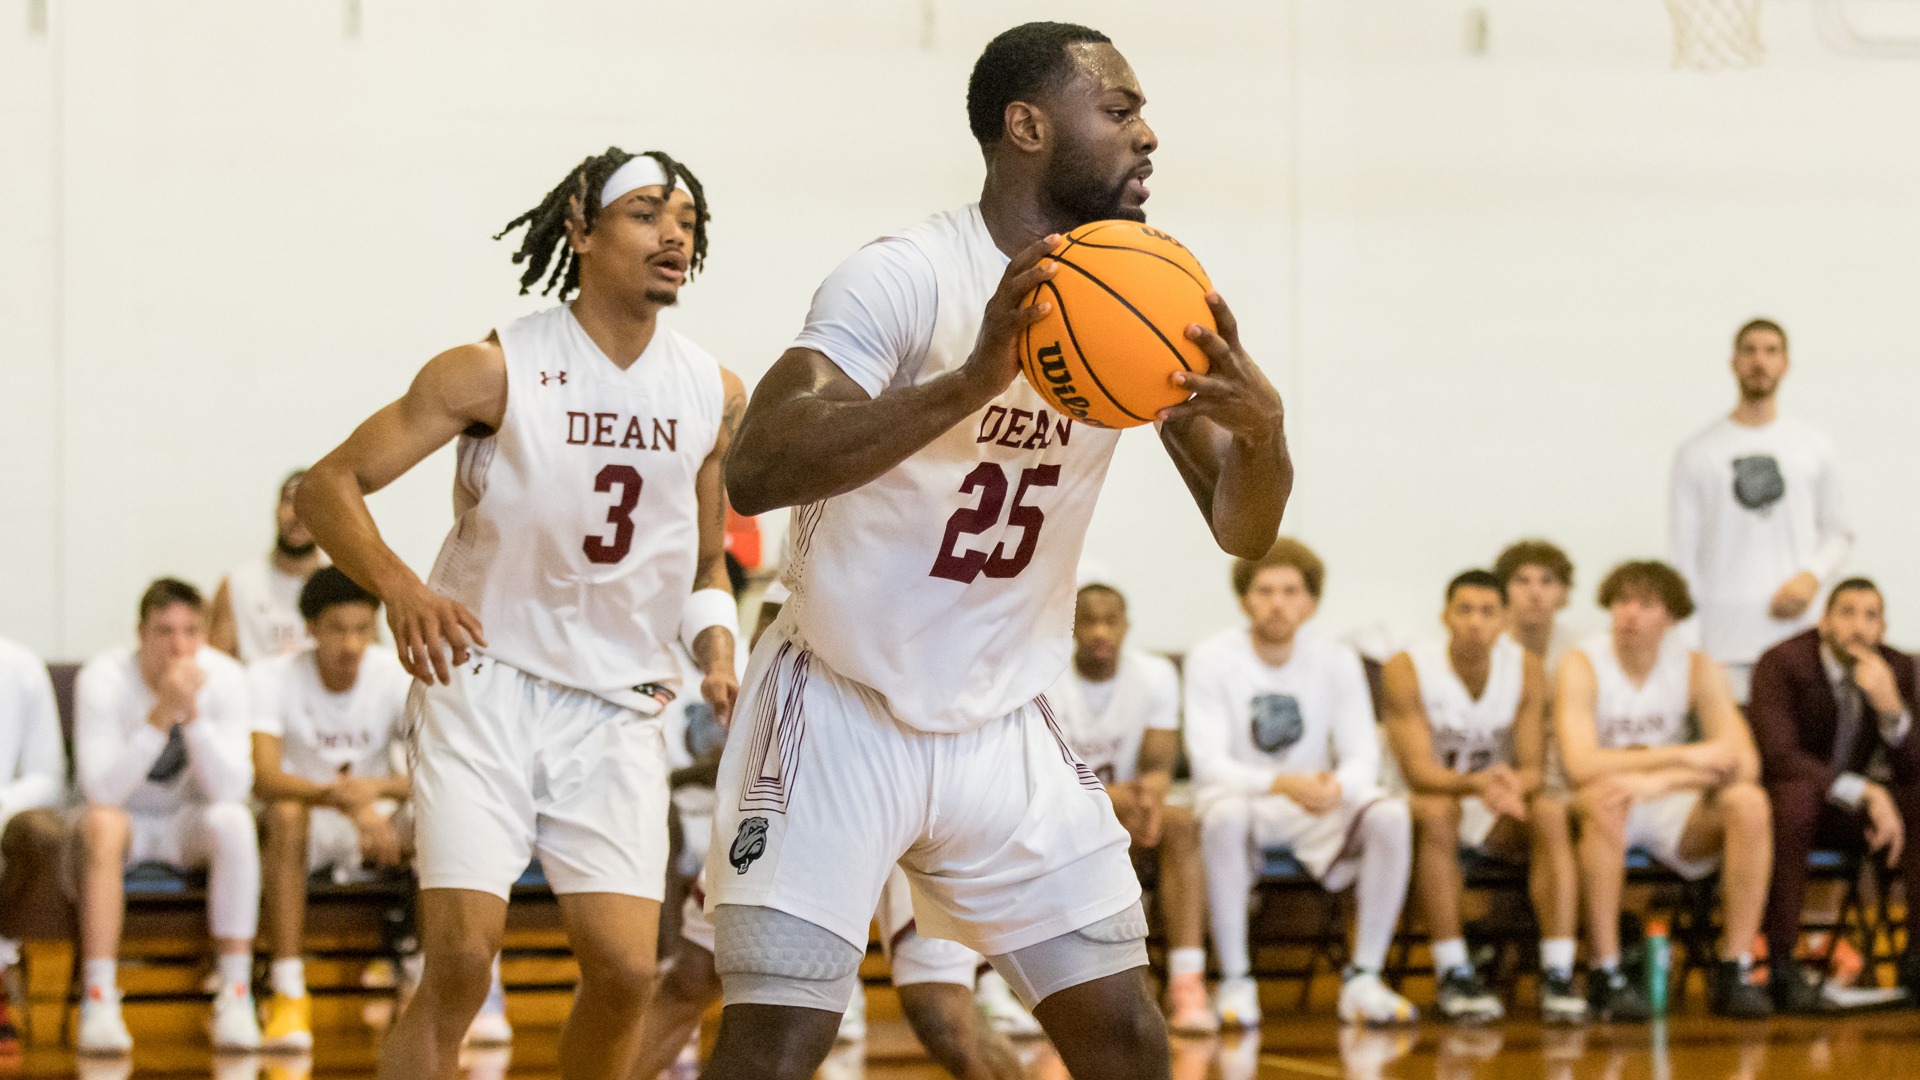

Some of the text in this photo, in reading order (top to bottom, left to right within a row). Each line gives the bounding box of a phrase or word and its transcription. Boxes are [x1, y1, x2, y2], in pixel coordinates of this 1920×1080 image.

[976, 405, 1073, 450] DEAN
[1037, 340, 1112, 428] Wilso
[566, 411, 677, 452] DEAN
[582, 464, 643, 564] 3
[929, 461, 1062, 585] 25
